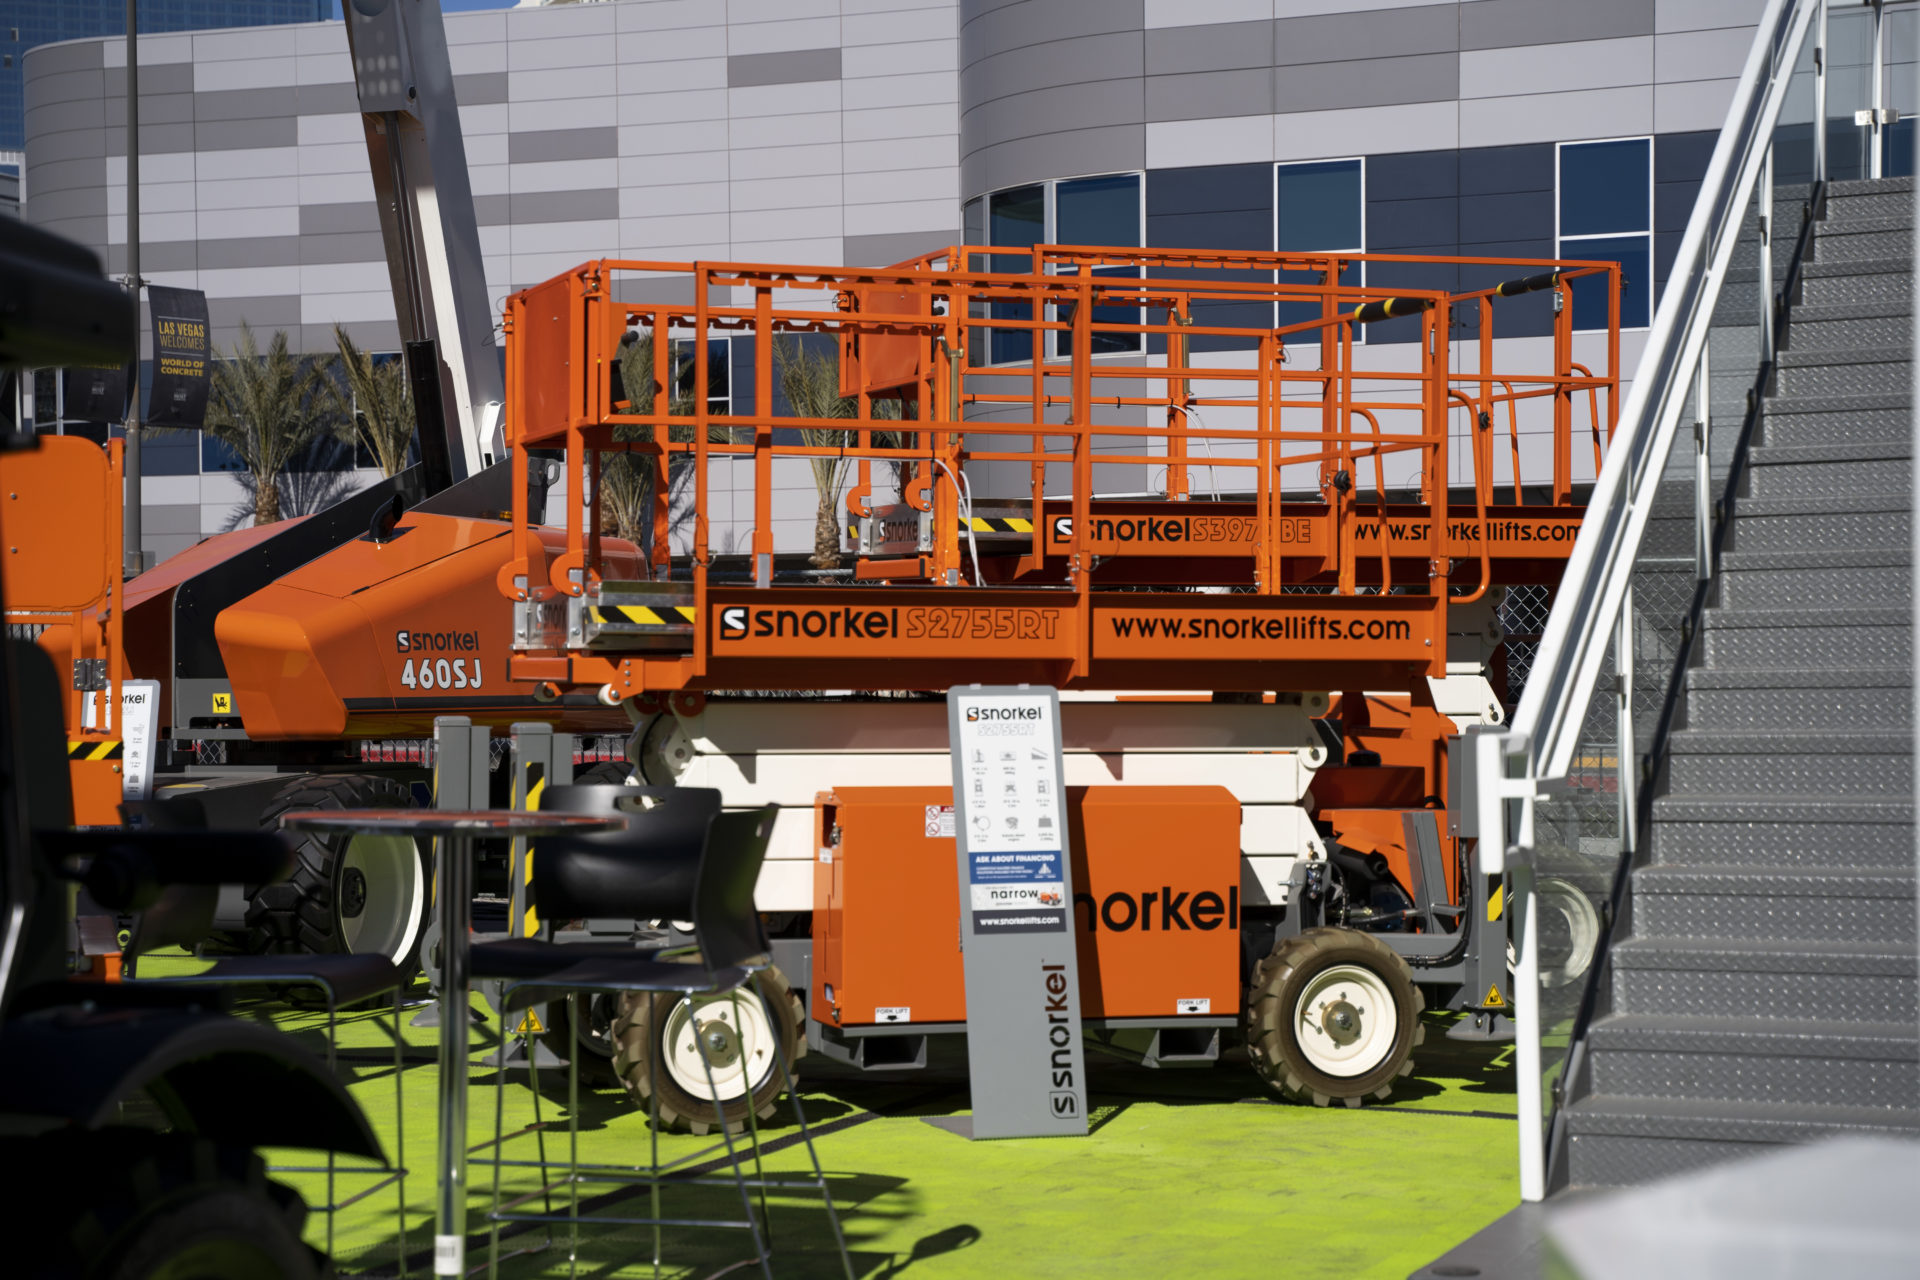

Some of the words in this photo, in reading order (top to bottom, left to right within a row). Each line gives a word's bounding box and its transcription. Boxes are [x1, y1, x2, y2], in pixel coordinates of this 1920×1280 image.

[158, 321, 175, 336] LAS
[177, 323, 205, 338] VEGAS
[160, 334, 205, 350] WELCOMES
[161, 358, 192, 367] WORLD
[161, 366, 204, 377] CONCRETE
[886, 519, 918, 542] snorke
[754, 608, 898, 639] snorkel
[907, 608, 1060, 639] S2755RT
[1111, 615, 1411, 640] www.snorkellifts.com
[412, 630, 480, 651] snorkel
[400, 657, 483, 691] 460SJ
[981, 706, 1042, 720] snorkel
[975, 855, 990, 863] ASK
[991, 854, 1015, 863] ABOUT
[1015, 853, 1056, 862] FINANCING
[991, 889, 1039, 899] narrow
[1073, 886, 1238, 932] norkel
[1042, 965, 1074, 1088] snorkel
